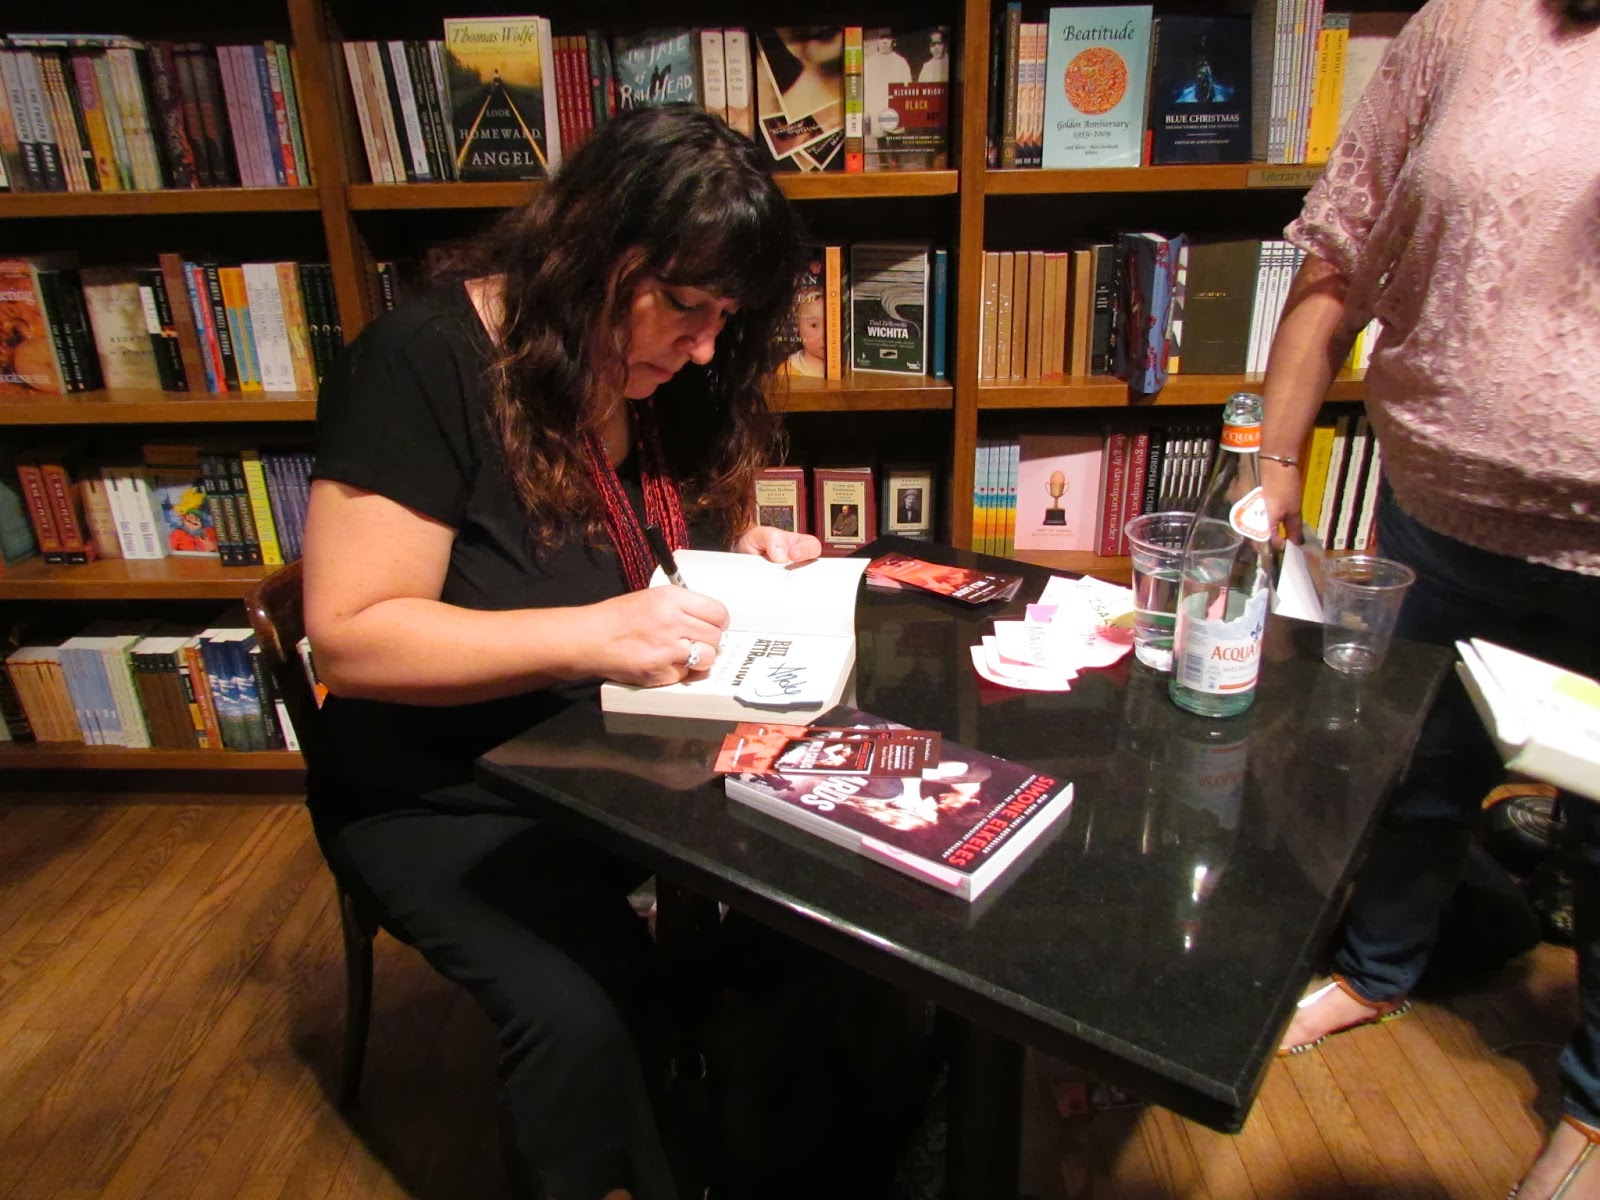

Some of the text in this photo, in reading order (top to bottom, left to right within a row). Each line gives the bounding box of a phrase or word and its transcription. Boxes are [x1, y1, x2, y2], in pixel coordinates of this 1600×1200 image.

[452, 24, 535, 47] Thomas Wolfe
[1063, 20, 1135, 42] Beatitude
[652, 74, 692, 100] HEAD
[893, 87, 920, 97] RICHARD
[486, 108, 511, 117] LOOK
[905, 100, 928, 110] BLACK
[1056, 120, 1130, 132] Golden Anniversary
[1165, 114, 1240, 124] BLUE CHRISTMAS
[16, 106, 29, 141] FROZEN
[25, 145, 38, 173] RABBI
[33, 106, 46, 141] FROZEN
[43, 145, 56, 173] RABBI
[472, 152, 534, 165] ANGEL
[1261, 171, 1300, 183] Literary
[210, 281, 220, 301] NORTH
[867, 326, 909, 339] WICHITA
[1222, 431, 1253, 445] CQUA
[1113, 451, 1124, 469] guy
[1136, 448, 1147, 466] guy
[1148, 451, 1159, 488] EUROPEAN
[1110, 468, 1122, 514] davenport
[1132, 466, 1147, 512] davenport
[1107, 515, 1118, 542] reader
[766, 640, 792, 658] RUL
[1211, 644, 1255, 662] ACQUA
[800, 777, 869, 812] ARDS
[1005, 793, 1015, 803] THE
[1037, 793, 1048, 804] NEW
[986, 801, 1006, 819] PERFECT
[1025, 803, 1038, 816] YORK
[948, 776, 1056, 866] SIMONE ELKELES
[1010, 814, 1025, 829] TIMES
[942, 839, 963, 859] TRILOGY
